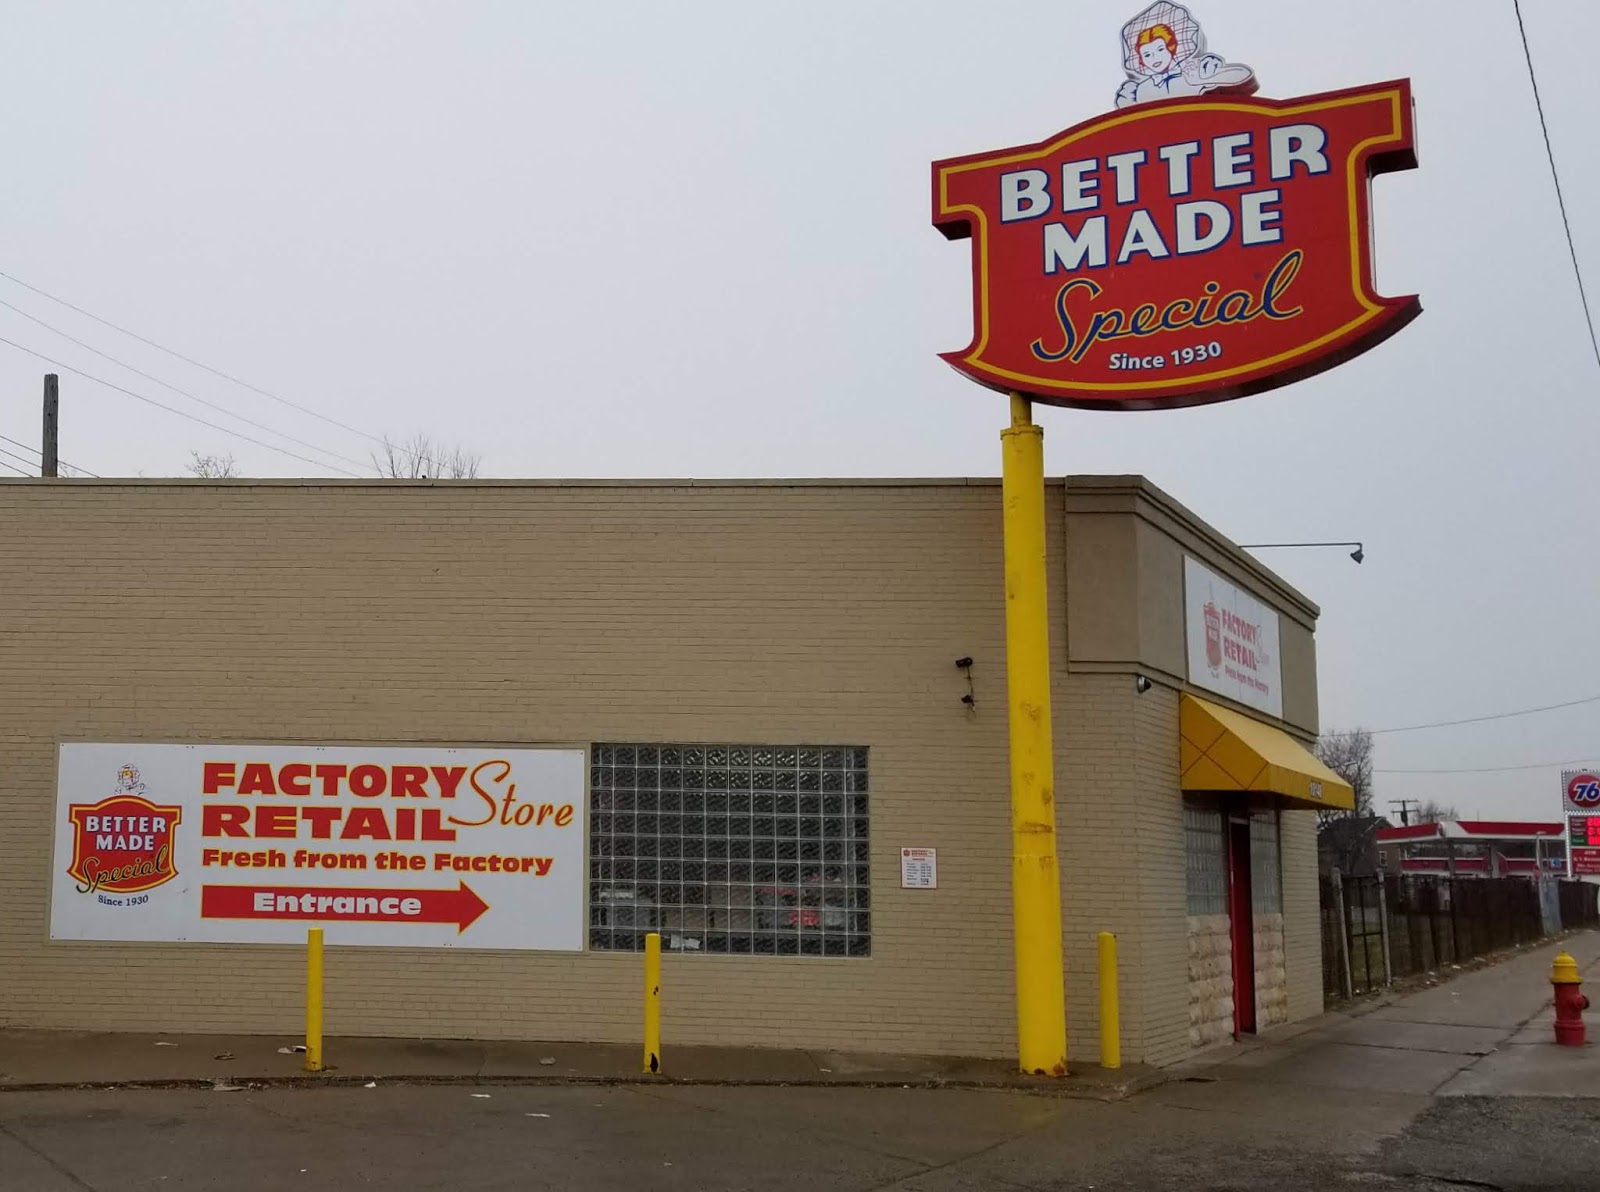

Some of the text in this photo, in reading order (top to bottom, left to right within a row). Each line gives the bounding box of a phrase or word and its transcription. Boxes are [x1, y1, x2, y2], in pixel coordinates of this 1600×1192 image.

[1001, 123, 1330, 224] BETTER
[1043, 189, 1284, 275] MADE
[1030, 249, 1304, 364] Special
[1109, 341, 1222, 371] Since 1930
[1222, 609, 1257, 645] FACTORY
[1223, 635, 1257, 672] RETAIL
[203, 761, 469, 798] FACTORY
[447, 760, 573, 828] Store
[1573, 782, 1600, 801] 76
[86, 816, 166, 832] BETTER
[201, 804, 457, 842] RETAIL
[96, 835, 154, 850] MADE
[76, 844, 169, 894] Special
[203, 848, 553, 876] Fresh from the Factory
[98, 894, 149, 907] Since 1930
[253, 891, 422, 915] Entrance
